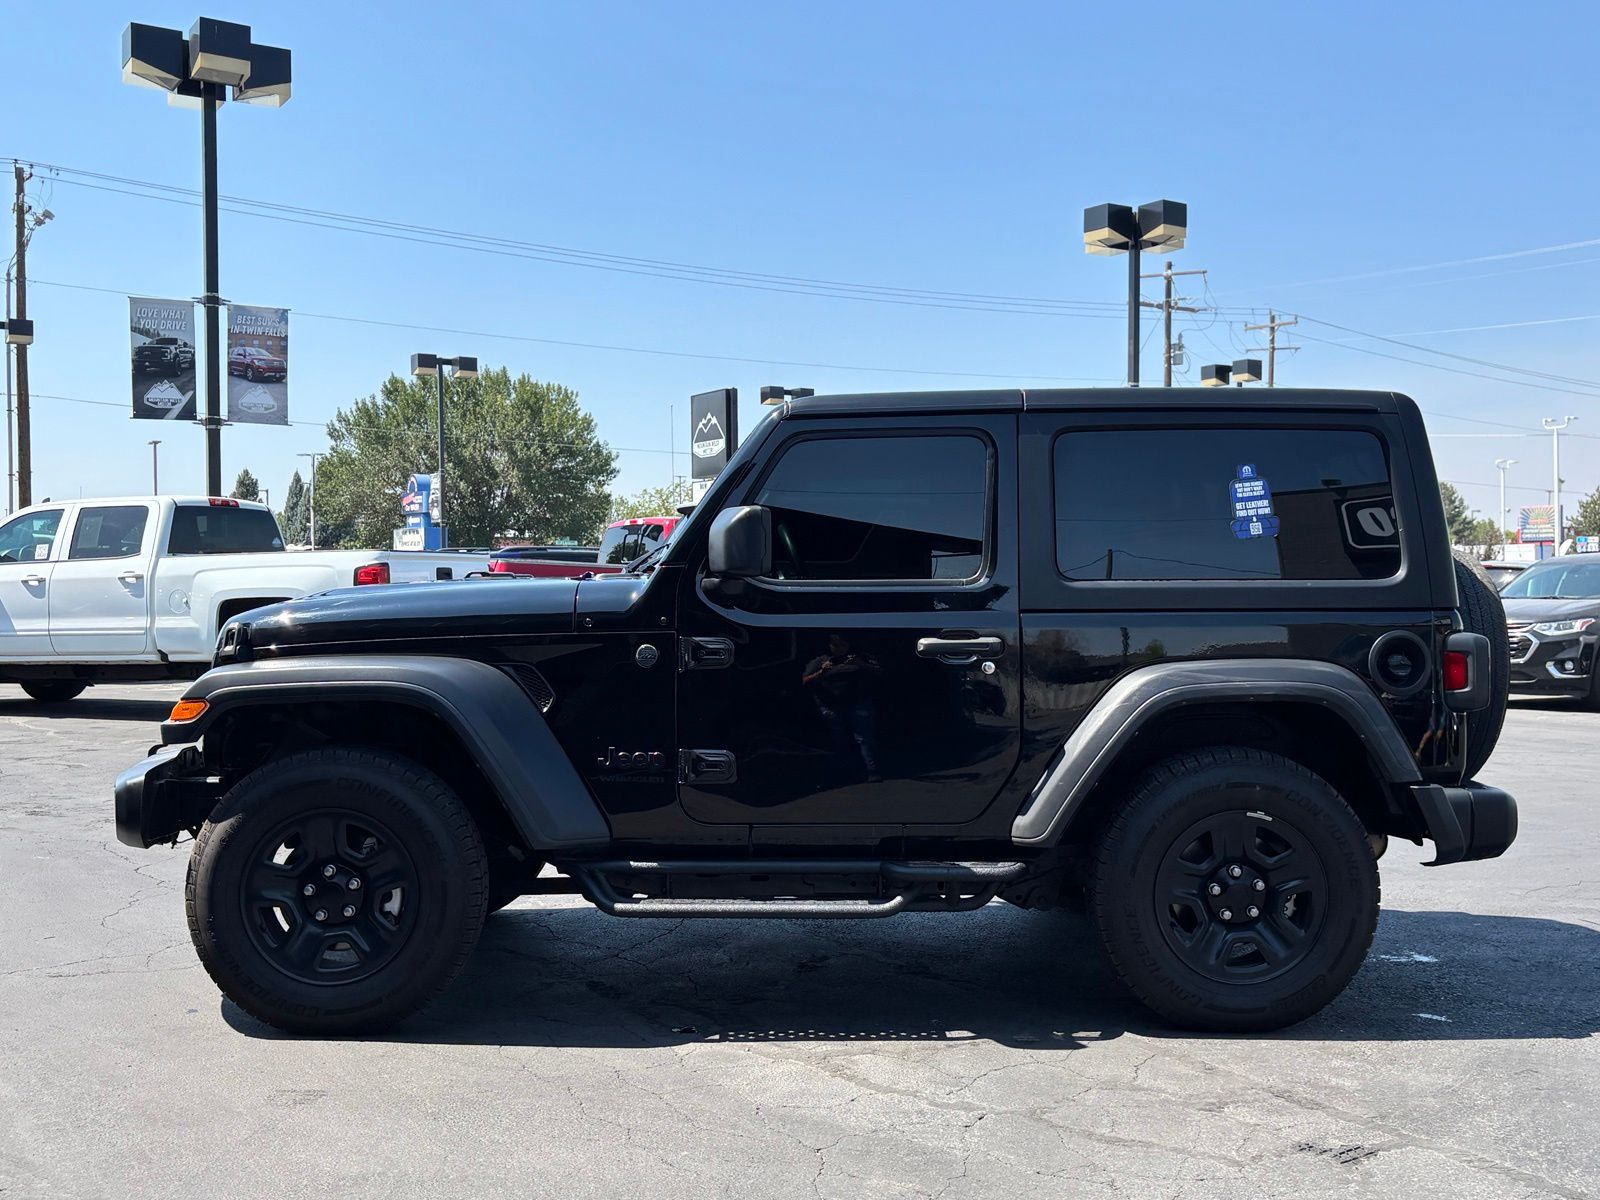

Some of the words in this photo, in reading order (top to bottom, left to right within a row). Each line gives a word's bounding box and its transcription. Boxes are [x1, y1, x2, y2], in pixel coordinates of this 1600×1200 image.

[136, 307, 158, 318] LOVE
[161, 309, 186, 319] WHAT
[140, 318, 158, 329] YOU
[160, 319, 187, 330] DRIVE
[237, 315, 256, 325] BEST
[230, 324, 241, 334] IN
[242, 326, 263, 335] TWIN
[264, 327, 287, 338] FALLS
[1246, 500, 1269, 508] LEATHER!
[597, 746, 665, 769] Jeep
